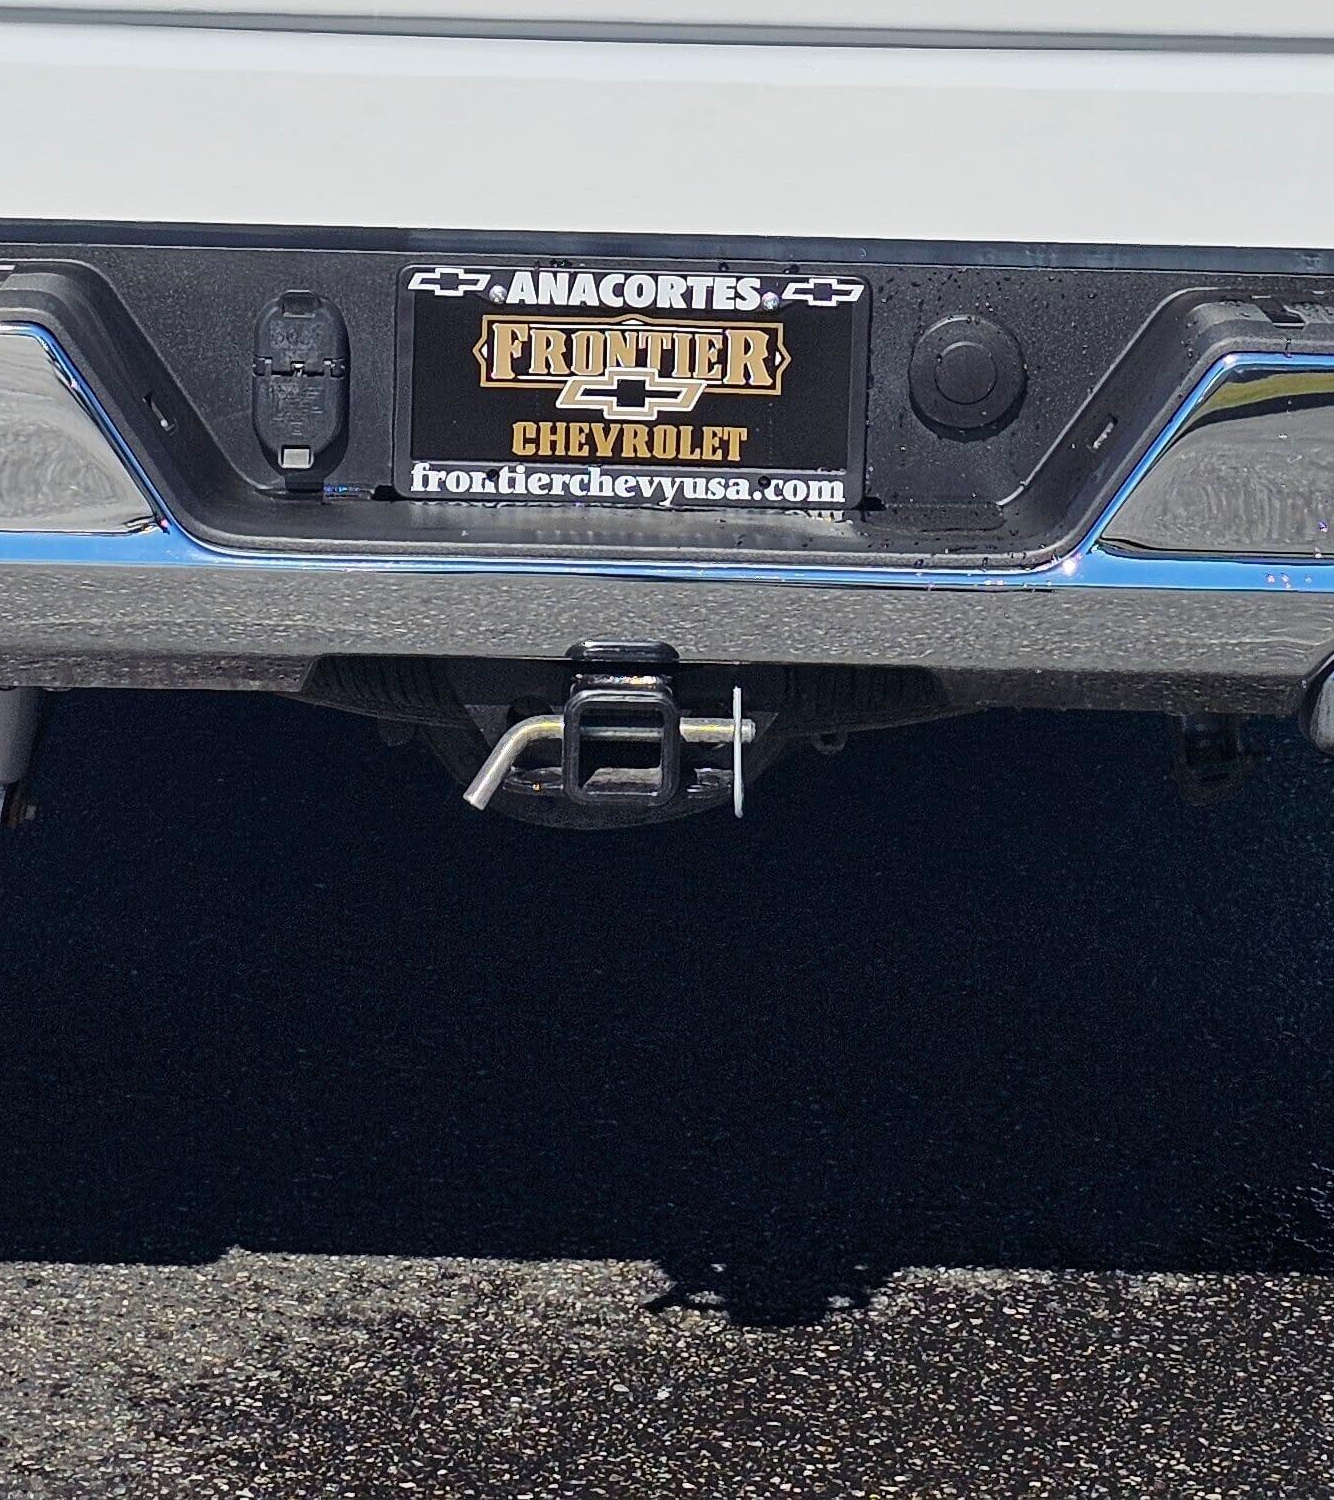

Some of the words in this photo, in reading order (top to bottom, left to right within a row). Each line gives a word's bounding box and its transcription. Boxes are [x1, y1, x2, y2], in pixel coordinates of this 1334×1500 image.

[506, 271, 761, 311] ANACORTES
[492, 323, 772, 386] FRONTIER
[512, 422, 747, 461] CHEVROLET
[410, 464, 845, 506] frontierchevyusa.com
